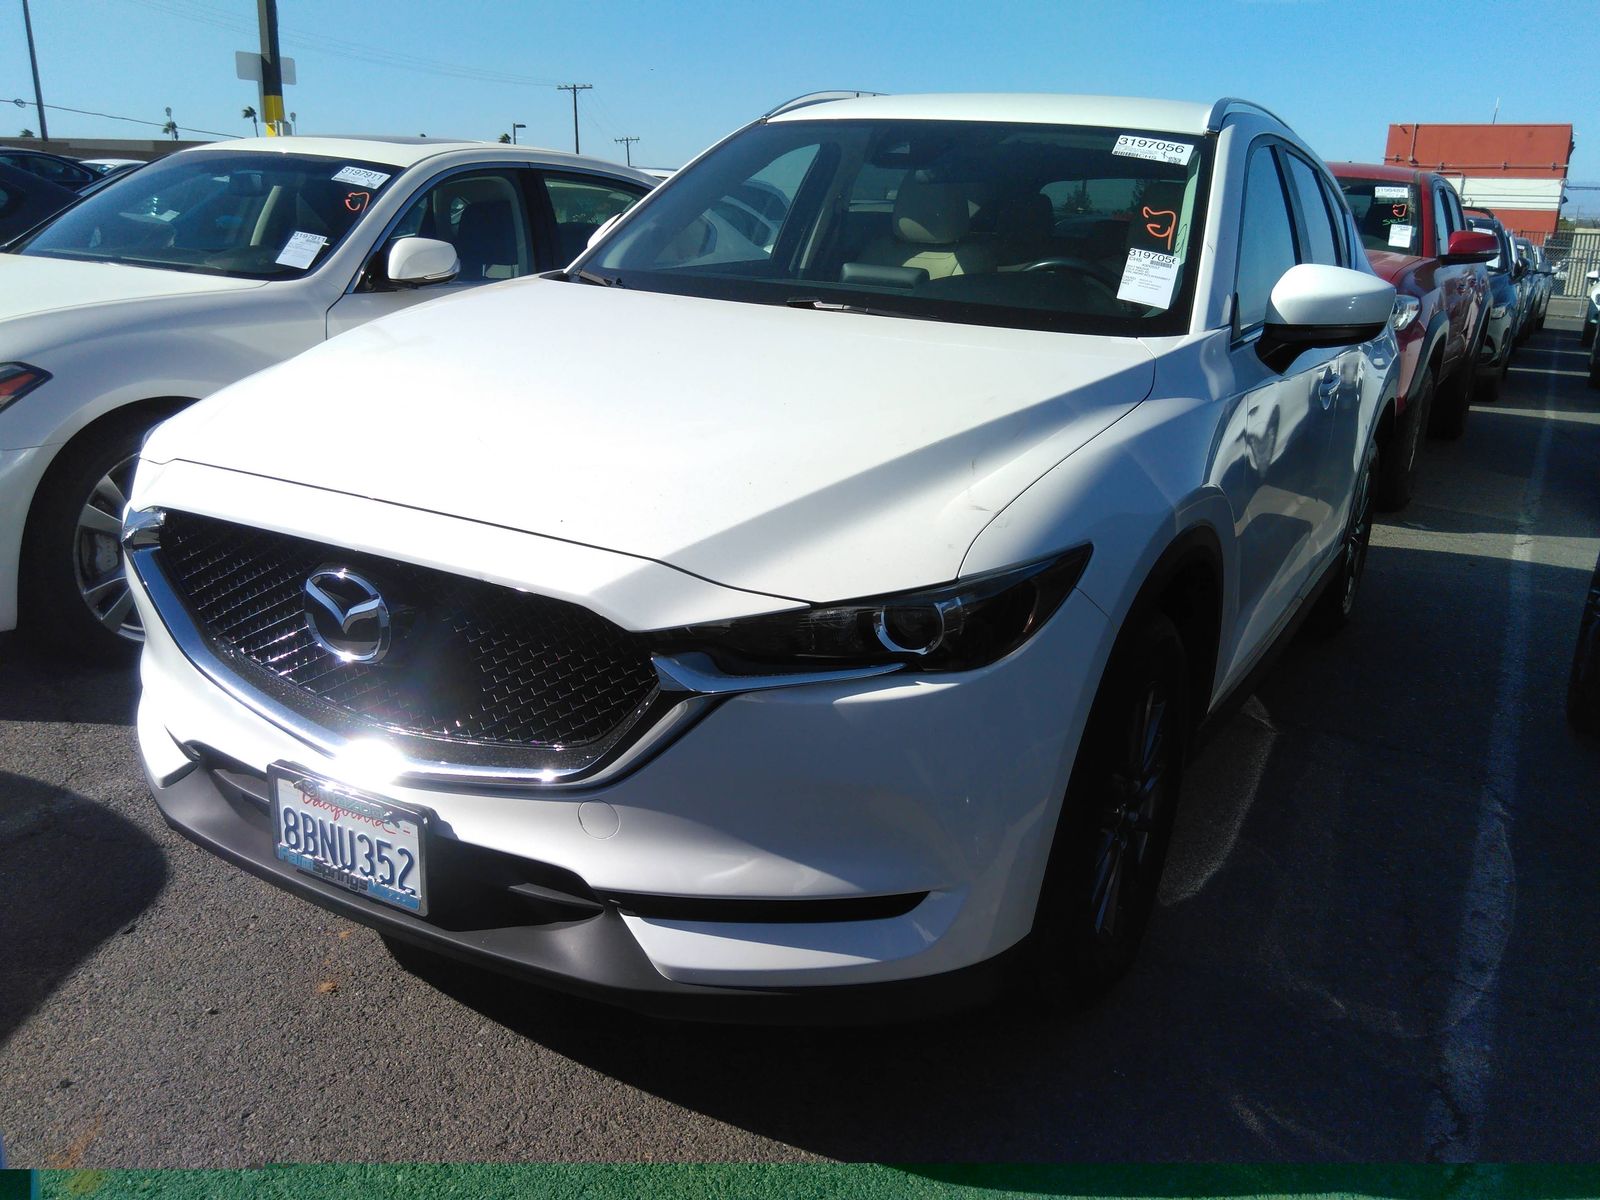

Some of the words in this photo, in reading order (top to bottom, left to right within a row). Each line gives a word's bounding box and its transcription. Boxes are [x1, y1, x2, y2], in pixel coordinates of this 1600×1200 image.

[1118, 136, 1185, 154] 3197056
[341, 167, 383, 181] 3197911
[283, 806, 417, 896] 8BNU352
